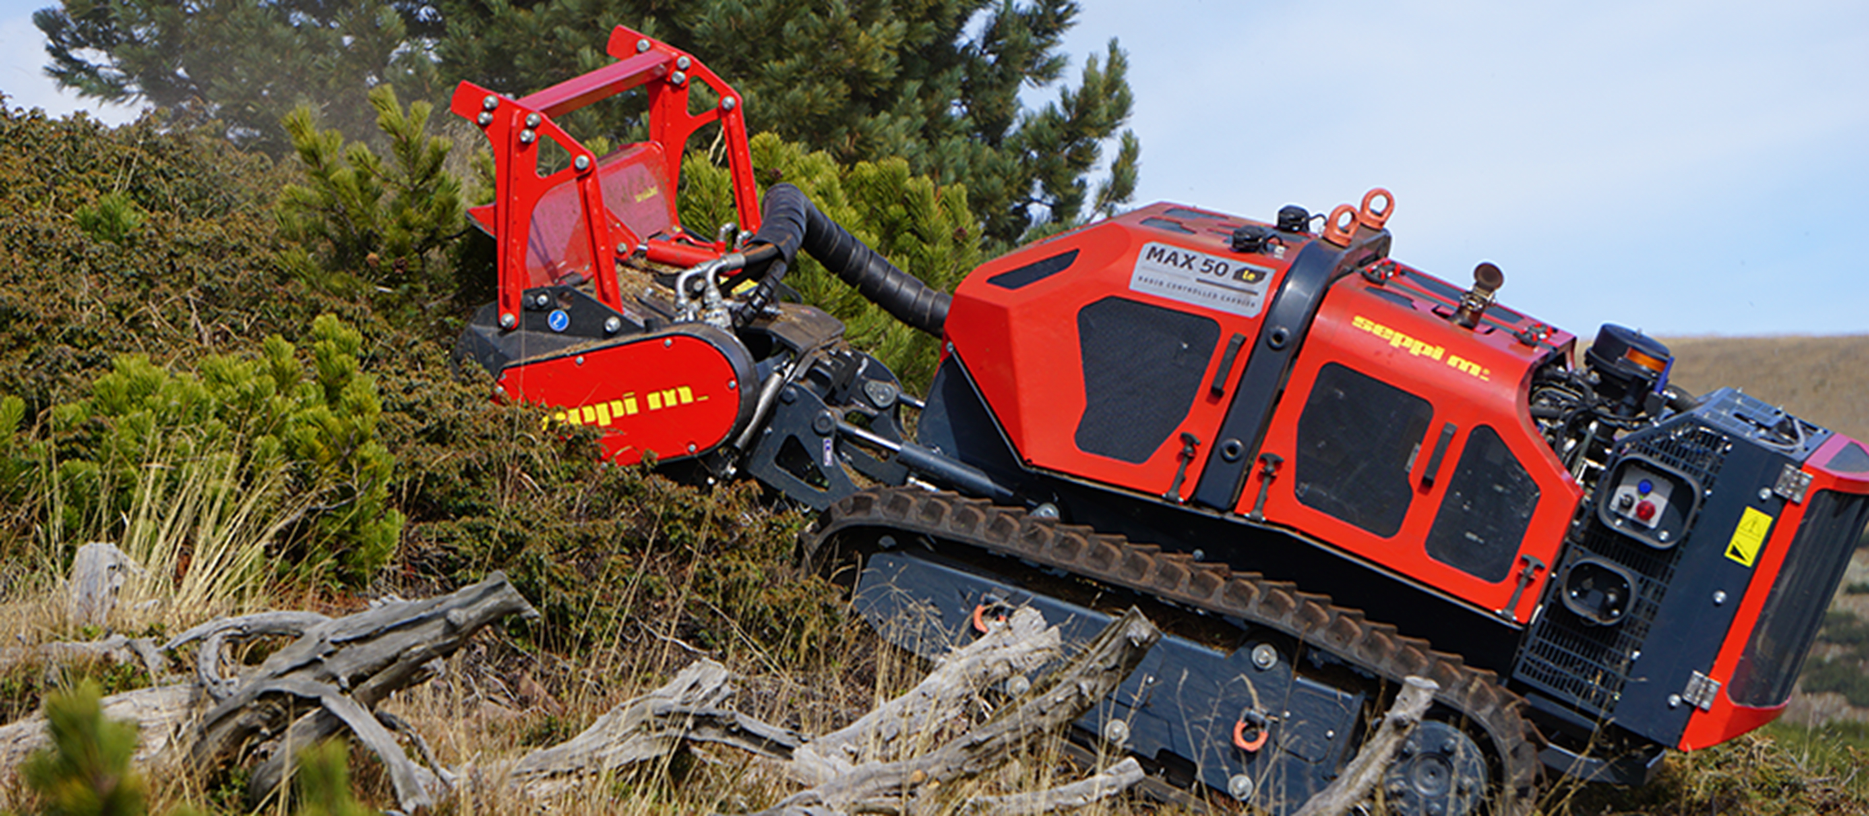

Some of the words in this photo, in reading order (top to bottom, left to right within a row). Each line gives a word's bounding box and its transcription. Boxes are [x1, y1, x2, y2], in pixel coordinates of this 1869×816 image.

[1146, 246, 1196, 271] MAX
[1199, 258, 1229, 278] 50
[1166, 281, 1218, 300] CONTROLLED
[1351, 315, 1445, 361] seppi
